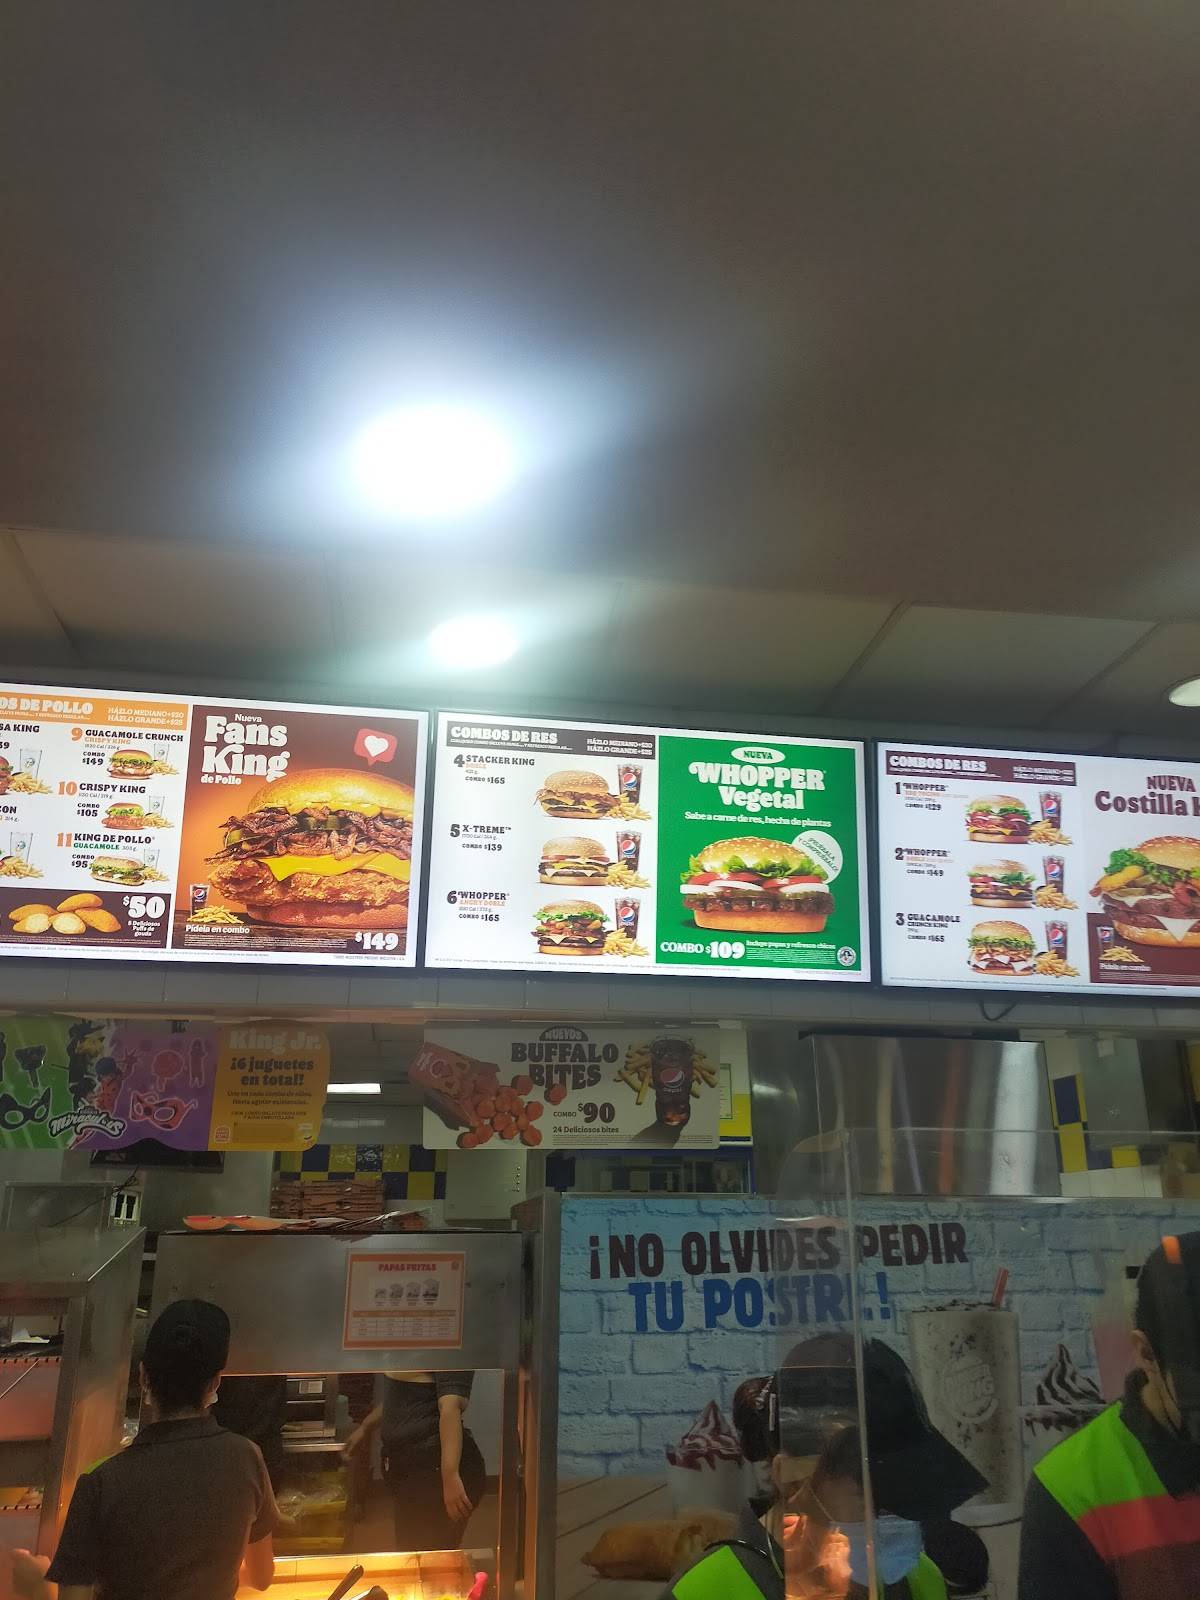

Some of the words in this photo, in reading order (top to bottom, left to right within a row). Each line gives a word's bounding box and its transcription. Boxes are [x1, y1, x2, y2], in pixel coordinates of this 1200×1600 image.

[20, 698, 41, 711] DE
[42, 699, 94, 714] POLLO
[235, 713, 263, 723] Nueva
[13, 724, 40, 733] KING
[71, 728, 82, 741] 9
[85, 729, 143, 740] GUACAMOLE
[145, 732, 184, 742] CRUNCH
[204, 715, 289, 747] Fans
[451, 727, 510, 741] COMBOS
[511, 729, 530, 742] DE
[530, 731, 558, 744] RES
[82, 755, 104, 766] $149
[453, 754, 465, 768] 4
[465, 755, 510, 765] STACKER
[511, 758, 535, 766] KING
[743, 750, 773, 760] NUEVA
[201, 744, 291, 784] King
[889, 755, 944, 770] COMBOS
[944, 759, 962, 771] DE
[962, 760, 987, 773] RES
[200, 774, 214, 784] de
[215, 775, 243, 786] Pollo
[487, 777, 506, 785] $165
[1147, 775, 1196, 792] NUEVA
[57, 781, 78, 796] 10
[79, 782, 118, 792] CRISPY
[119, 785, 146, 794] KING
[895, 782, 901, 795] 1
[718, 785, 804, 813] Vegetal
[1095, 790, 1189, 816] Costilla
[77, 808, 98, 817] $105
[684, 811, 706, 820] Sabe
[449, 824, 461, 838] 5
[57, 833, 73, 848] 11
[74, 833, 101, 842] KING
[102, 834, 116, 843] DE
[73, 842, 120, 850] GUACAMOLE
[484, 843, 502, 851] $139
[895, 847, 904, 860] 2
[71, 860, 88, 869] $95
[447, 890, 458, 904] 6
[122, 895, 166, 919] $50
[481, 913, 500, 922] $165
[896, 912, 905, 926] 3
[907, 913, 961, 923] GUACAMOLE
[222, 926, 251, 934] combo
[355, 932, 399, 951] $149
[660, 940, 705, 954] COMBO
[705, 940, 746, 960] $109
[545, 1028, 582, 1041] NUEVOS
[230, 1029, 288, 1056] King
[511, 1042, 619, 1064] BUFFALO
[248, 1056, 315, 1073] juguetes
[241, 1075, 260, 1086] en
[262, 1073, 305, 1087] total!
[528, 1063, 602, 1090] BITES
[577, 1102, 616, 1124] $90
[553, 1125, 563, 1134] 24
[564, 1124, 601, 1134] Deliciosos
[601, 1125, 619, 1134] bites
[589, 1233, 664, 1279] ¡NO
[681, 1226, 841, 1275] OLVIDES
[855, 1222, 969, 1267] PEDIR
[378, 1263, 405, 1272] PAPAS
[406, 1263, 437, 1272] FRITAS
[628, 1280, 686, 1333] TU
